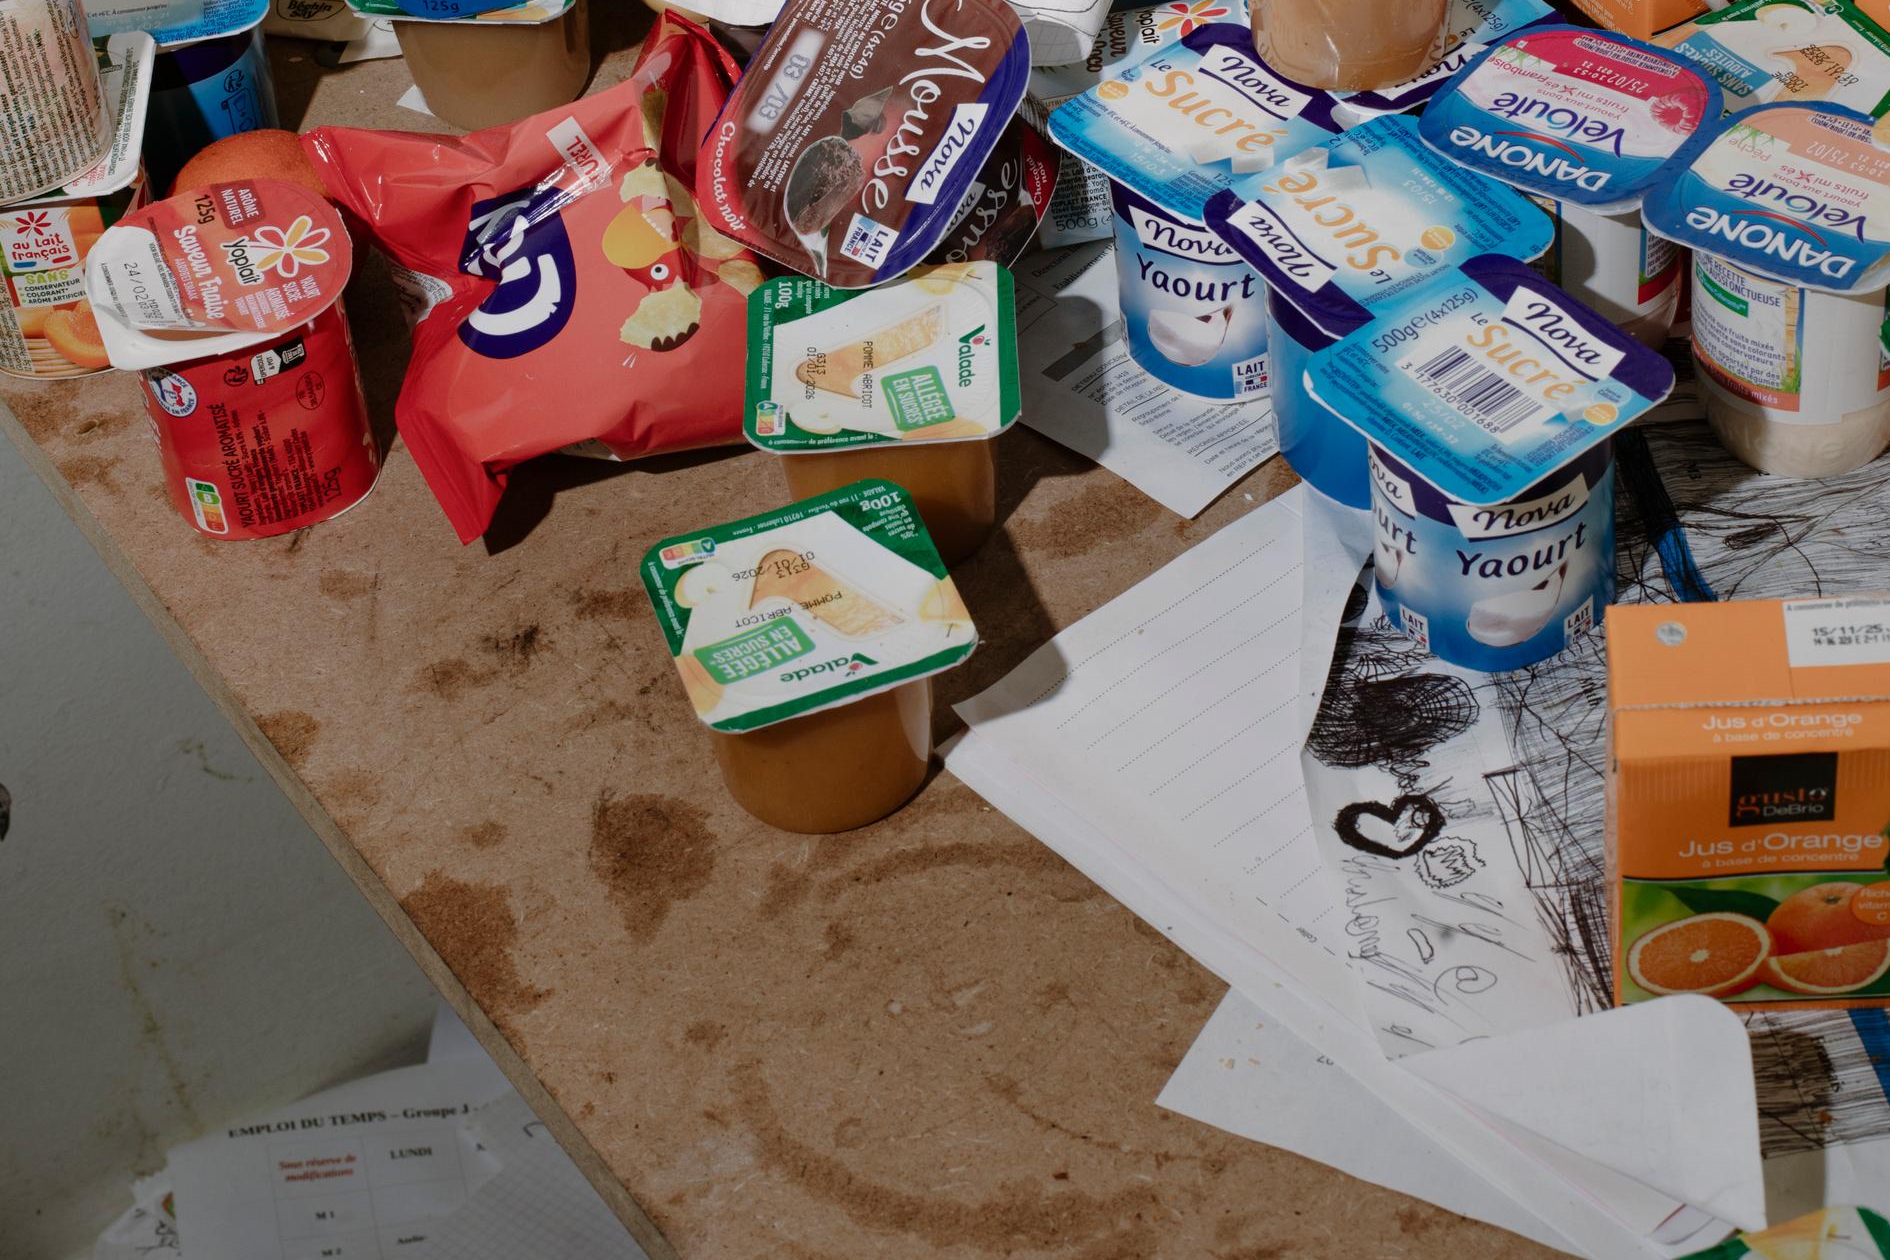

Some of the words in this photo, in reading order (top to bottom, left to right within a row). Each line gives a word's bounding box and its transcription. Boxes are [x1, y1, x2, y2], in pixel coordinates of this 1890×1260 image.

[423, 0, 460, 13] 125g
[843, 41, 861, 69] CHOCOLAT
[1150, 58, 1172, 72] Le
[834, 70, 846, 86] NOIR
[1222, 55, 1291, 108] Nova
[1719, 72, 1754, 95] SANS
[1145, 70, 1288, 154] Sucré
[1494, 92, 1625, 158] Velouté
[802, 125, 813, 137] LAIT
[922, 118, 975, 191] Nova
[1449, 124, 1612, 192] DANONE
[706, 120, 736, 205] Chocolat
[721, 202, 747, 232] noir
[776, 160, 790, 185] LACTOSE
[195, 194, 215, 224] 125g
[220, 189, 244, 226] NATUREL
[238, 188, 259, 218] ARÔME
[1729, 173, 1865, 243] Velouté
[1262, 170, 1401, 270] Sucré
[12, 243, 71, 262] français
[13, 240, 31, 252] au
[34, 232, 64, 249] Lait
[843, 228, 863, 254] FRANCE
[867, 229, 889, 263] LAIT
[1250, 214, 1310, 278] Nova
[1686, 206, 1857, 279] DANONE
[24, 277, 81, 292] CONSERVATEUR
[25, 268, 69, 284] SANS
[123, 262, 149, 302] 24/02
[301, 274, 321, 300] YAOURT
[1136, 252, 1256, 302] Yaourt
[1367, 267, 1392, 285] Le
[1714, 259, 1747, 287] RECETTE
[28, 295, 52, 304] ARÔME
[282, 281, 303, 303] SUCRÉ
[775, 281, 793, 310] 100g
[1729, 282, 1782, 308] ONCTUEUSE
[1425, 287, 1479, 326] (4x125g)
[1470, 311, 1489, 326] Le
[1527, 300, 1603, 367] Nova
[863, 341, 874, 370] POMME
[958, 323, 991, 388] Valade
[1237, 361, 1265, 377] LAIT
[1466, 322, 1578, 402] Sucré
[862, 373, 873, 409] ABRICOT
[892, 378, 908, 395] EN
[911, 373, 948, 421] ALLÉGÉE
[1243, 382, 1268, 393] FRANCE
[207, 401, 239, 457] AROMATISÉ
[221, 458, 247, 490] SUCRÉ
[321, 466, 342, 502] 125g
[233, 492, 256, 529] YAOURT
[859, 491, 902, 512] 100g
[1472, 491, 1577, 532] Nova
[1456, 522, 1587, 579] Yaourt
[801, 590, 843, 612] POMME
[735, 605, 792, 628] ABRICOT
[1401, 608, 1425, 632] LAIT
[1567, 606, 1591, 629] LAIT
[772, 626, 794, 643] EN
[722, 635, 803, 679] ALLÉGÉE
[780, 651, 880, 684] Valade
[1703, 714, 1747, 732] Jus
[1751, 711, 1863, 731] d'Orange
[1723, 731, 1755, 742] base
[1784, 725, 1854, 740] concentré
[1735, 787, 1829, 820] gusto
[1762, 801, 1825, 819] DeBrio
[1678, 838, 1735, 859] Jus
[1741, 830, 1884, 854] d'Orange
[1715, 855, 1754, 868] base
[1781, 850, 1861, 864] concentré
[228, 1120, 297, 1139] EMPLOI
[300, 1116, 325, 1130] DU
[329, 1109, 387, 1128] TEMPS
[402, 1104, 457, 1124] Groupe
[305, 1155, 340, 1169] réserve
[389, 1146, 434, 1161] LUNDI
[285, 1167, 354, 1183] modifications
